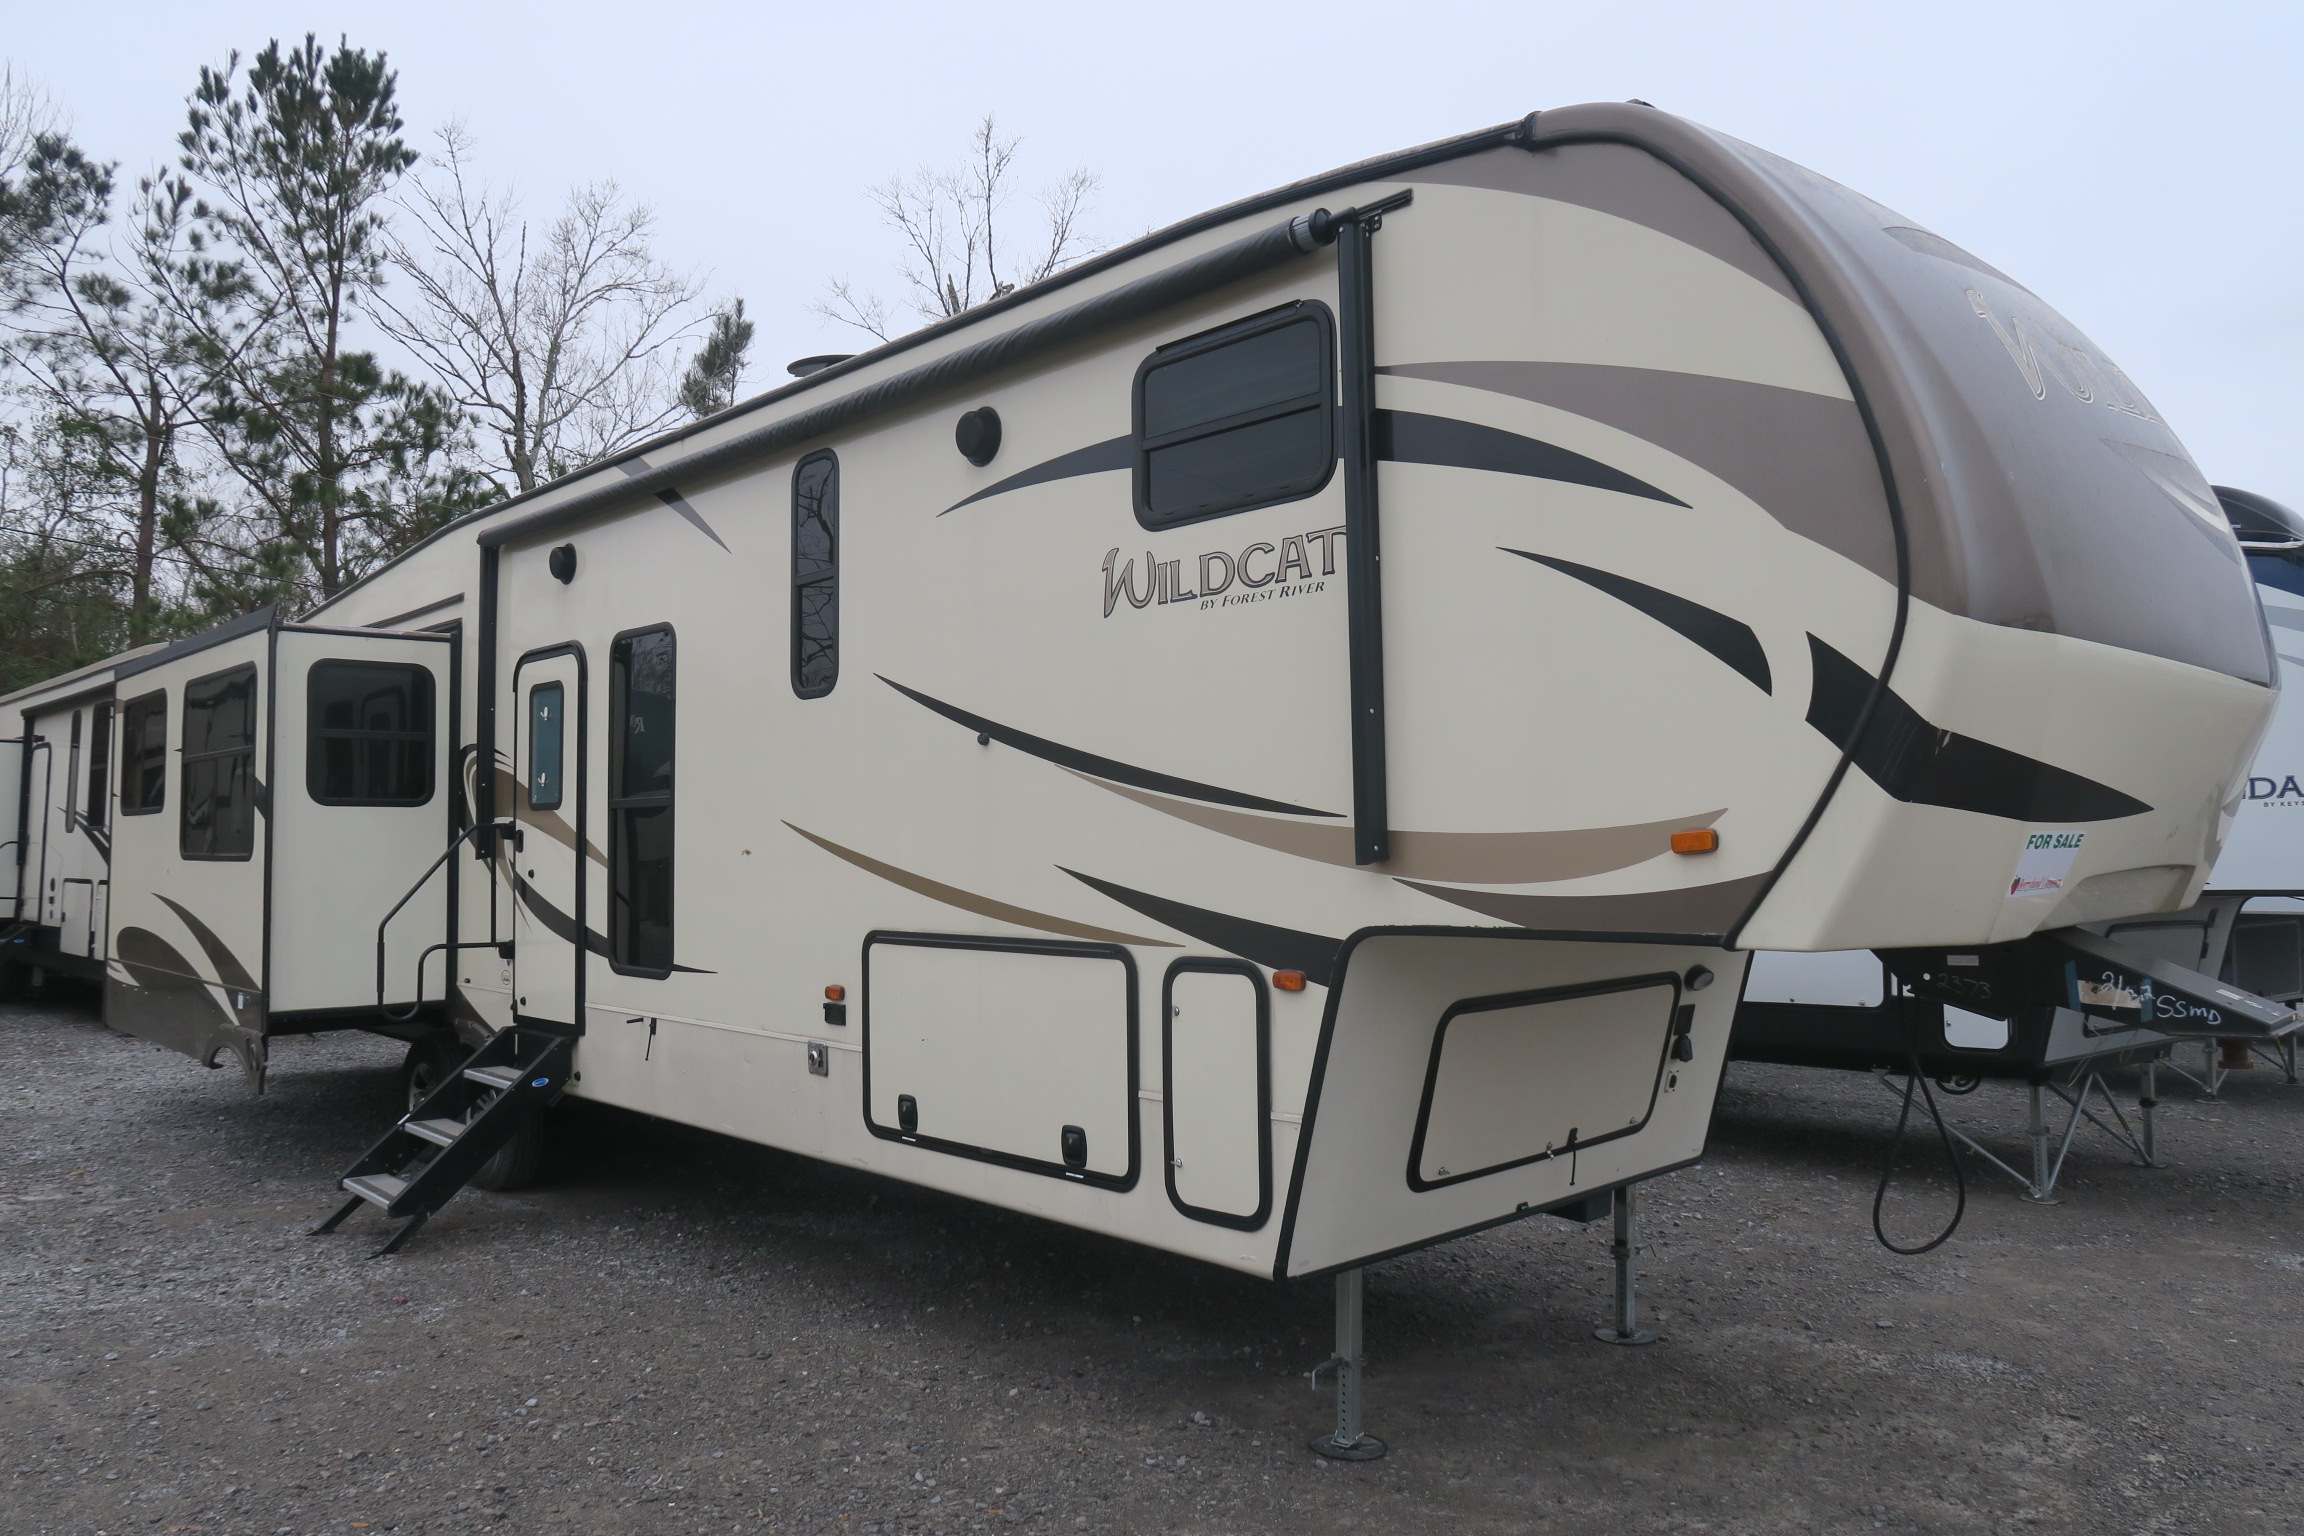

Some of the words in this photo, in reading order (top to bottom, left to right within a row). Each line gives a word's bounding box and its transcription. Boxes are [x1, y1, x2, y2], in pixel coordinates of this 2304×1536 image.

[1101, 524, 1347, 619] WILDCAT
[1200, 598, 1217, 611] BY
[1221, 588, 1277, 608] FOREST
[1279, 580, 1326, 600] RIVER
[2241, 774, 2304, 801] DA
[2025, 833, 2053, 850] FOR
[2053, 833, 2085, 849] SALE
[1936, 972, 1992, 999] 2373
